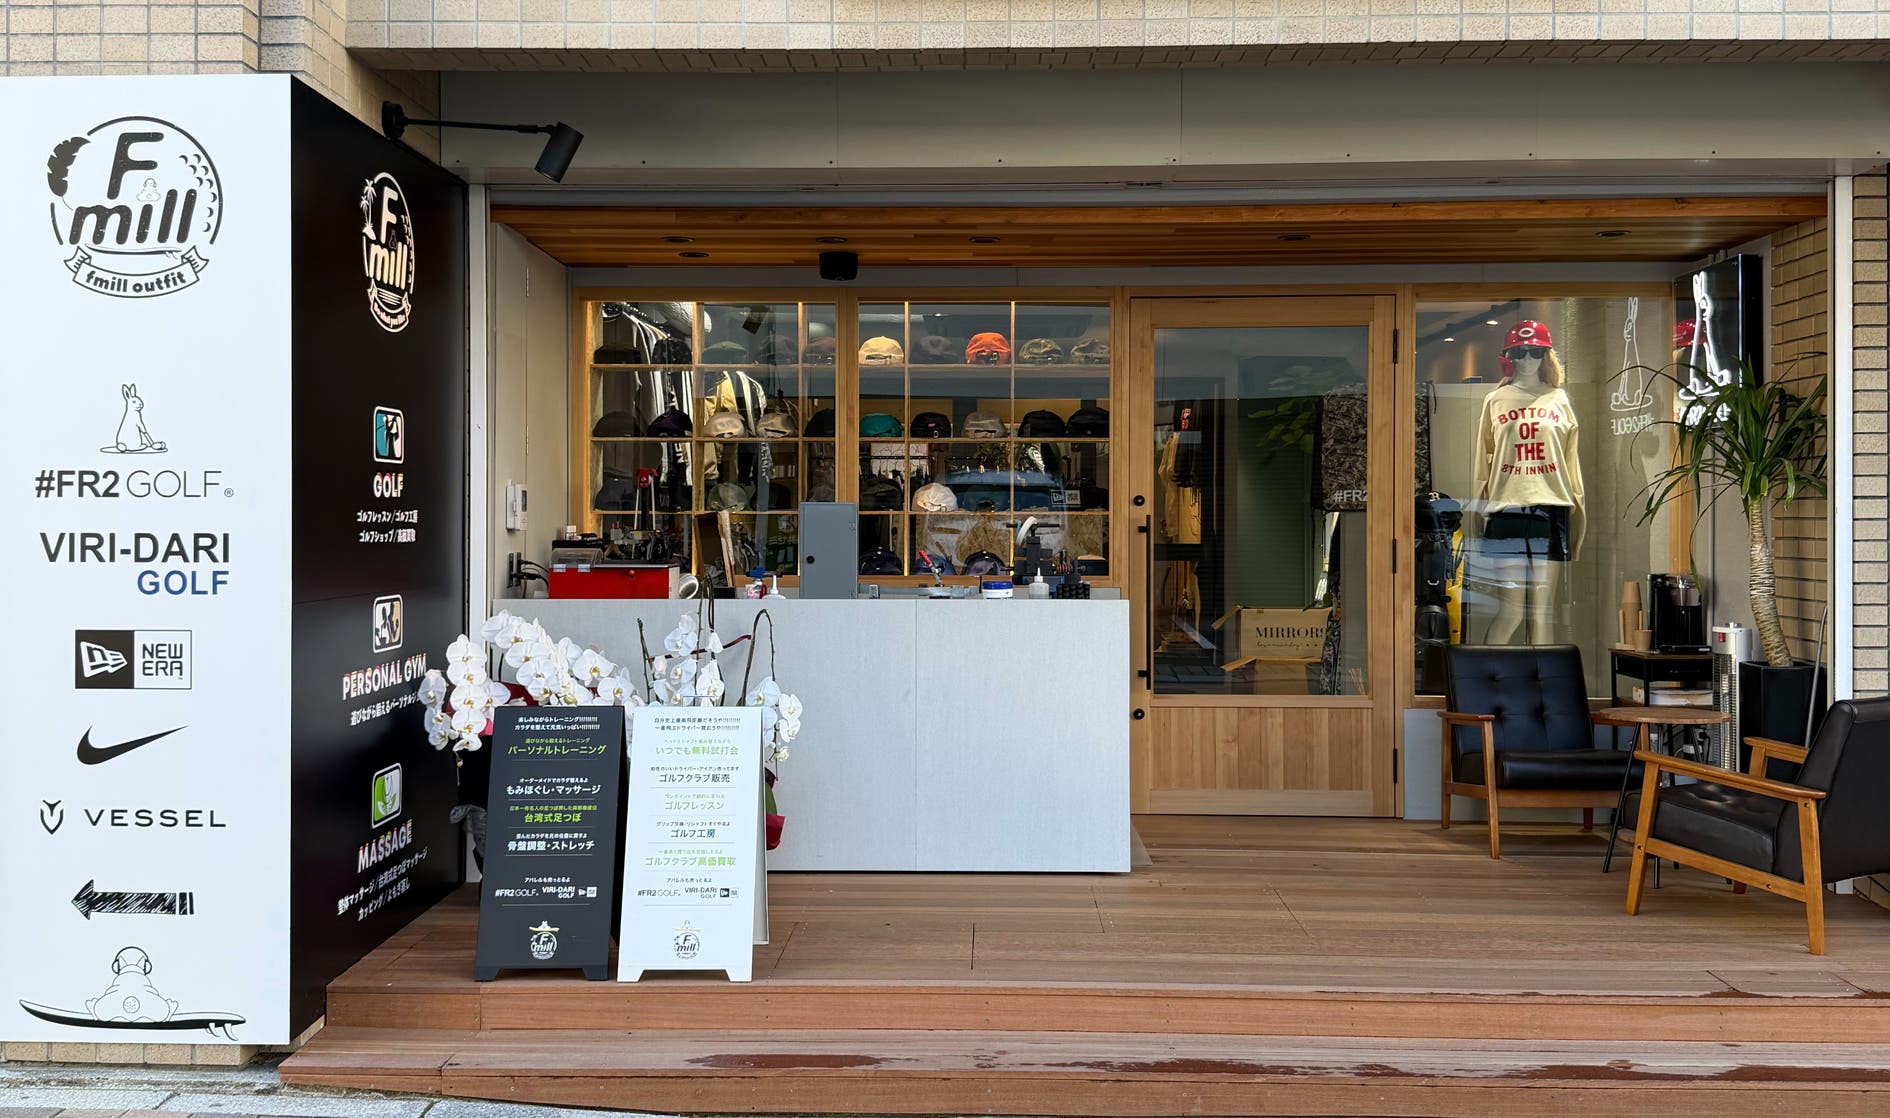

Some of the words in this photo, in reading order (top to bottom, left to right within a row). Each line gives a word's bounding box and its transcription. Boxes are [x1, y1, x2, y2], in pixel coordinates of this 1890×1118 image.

[107, 132, 164, 200] F
[69, 189, 197, 245] mill
[380, 186, 399, 244] F
[368, 242, 408, 290] mill
[85, 270, 128, 293] fmill
[132, 270, 187, 294] outfit
[1497, 407, 1560, 425] BOTTOM
[1518, 422, 1540, 440] OF
[1514, 442, 1546, 462] THE
[1501, 463, 1522, 475] 8TH
[35, 469, 120, 499] #FR2
[373, 472, 404, 498] GOLF
[40, 531, 230, 563] VIRI-DARI
[137, 569, 229, 595] GOLF
[142, 643, 183, 659] NEW
[142, 660, 183, 677] ERA
[342, 660, 403, 701] PERSONAL
[403, 653, 427, 682] GYM
[507, 744, 607, 755] パーソナルトレーニング
[659, 773, 730, 783] ゴルフクラブ販売
[506, 784, 601, 795] もみほぐし・マッサージ
[664, 801, 725, 811] ゴルフレッスン
[84, 809, 227, 828] VESSEL
[671, 828, 716, 838] ゴルフ工房
[357, 818, 413, 874] MASSAGE
